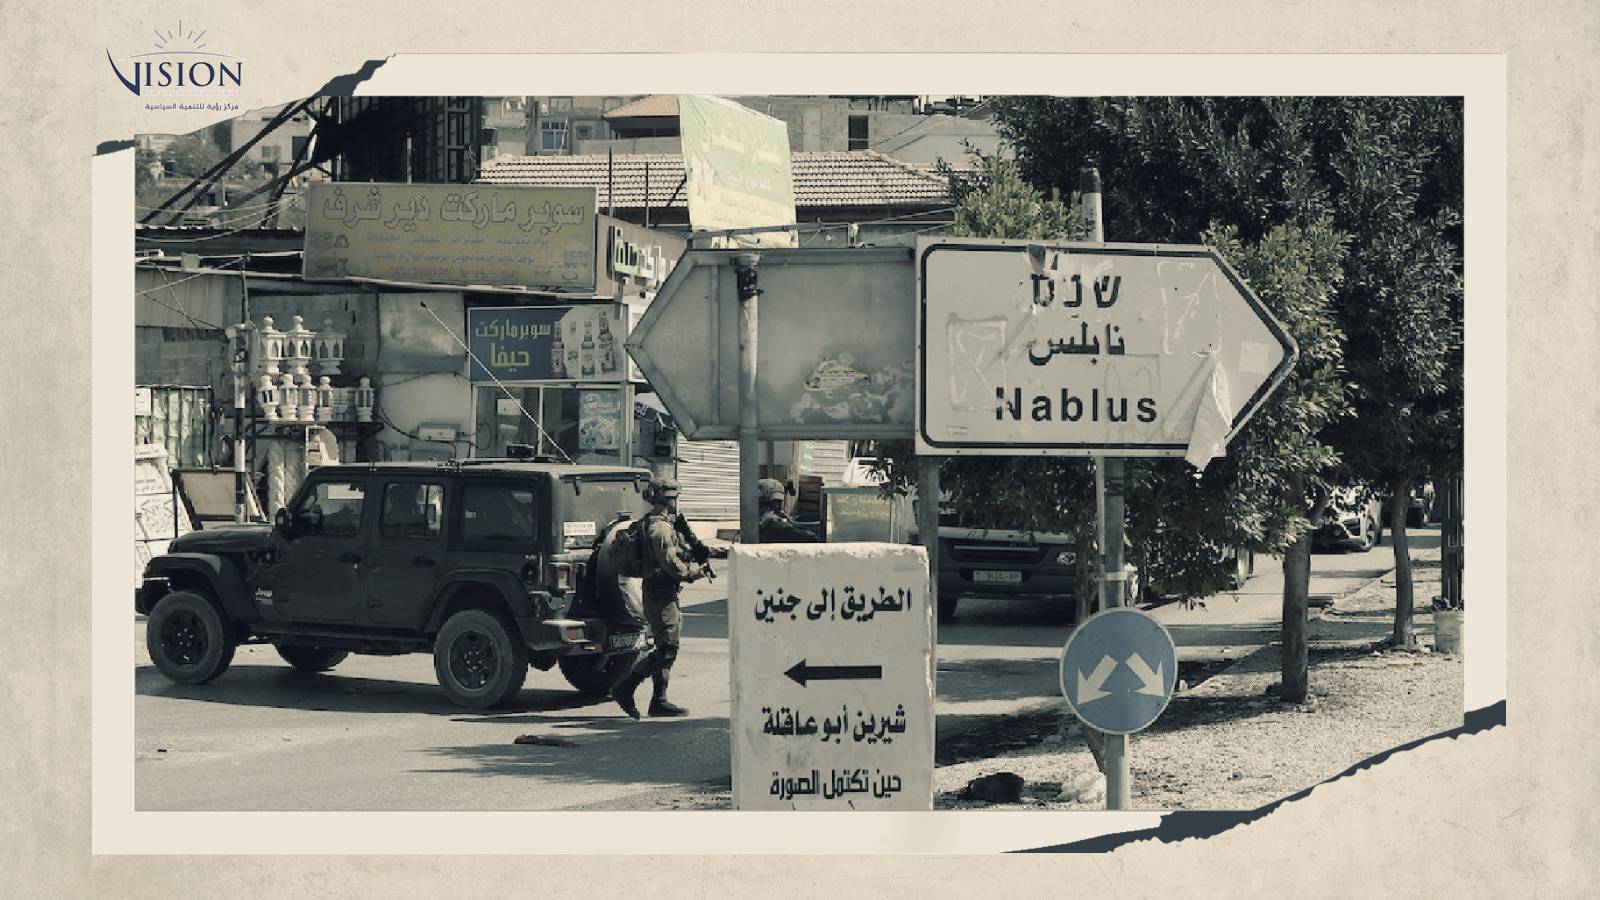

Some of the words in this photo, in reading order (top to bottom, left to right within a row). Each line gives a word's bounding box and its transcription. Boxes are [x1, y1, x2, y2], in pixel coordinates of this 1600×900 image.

[323, 186, 382, 229] شرف
[384, 196, 431, 232] دير
[440, 191, 516, 230] ماركت
[518, 201, 584, 235] سوبر
[490, 342, 530, 372] حيفا
[1028, 321, 1125, 366] نابلس
[995, 387, 1158, 422] Nablus
[754, 586, 802, 622] جنين
[806, 586, 836, 622] إلى
[840, 585, 912, 622] الطريق
[761, 706, 818, 736] عاقلة
[821, 704, 849, 744] أبو
[853, 704, 906, 743] شيرين
[769, 769, 820, 800] الصورة
[823, 769, 869, 800] تكتمل
[873, 768, 902, 798] حين
